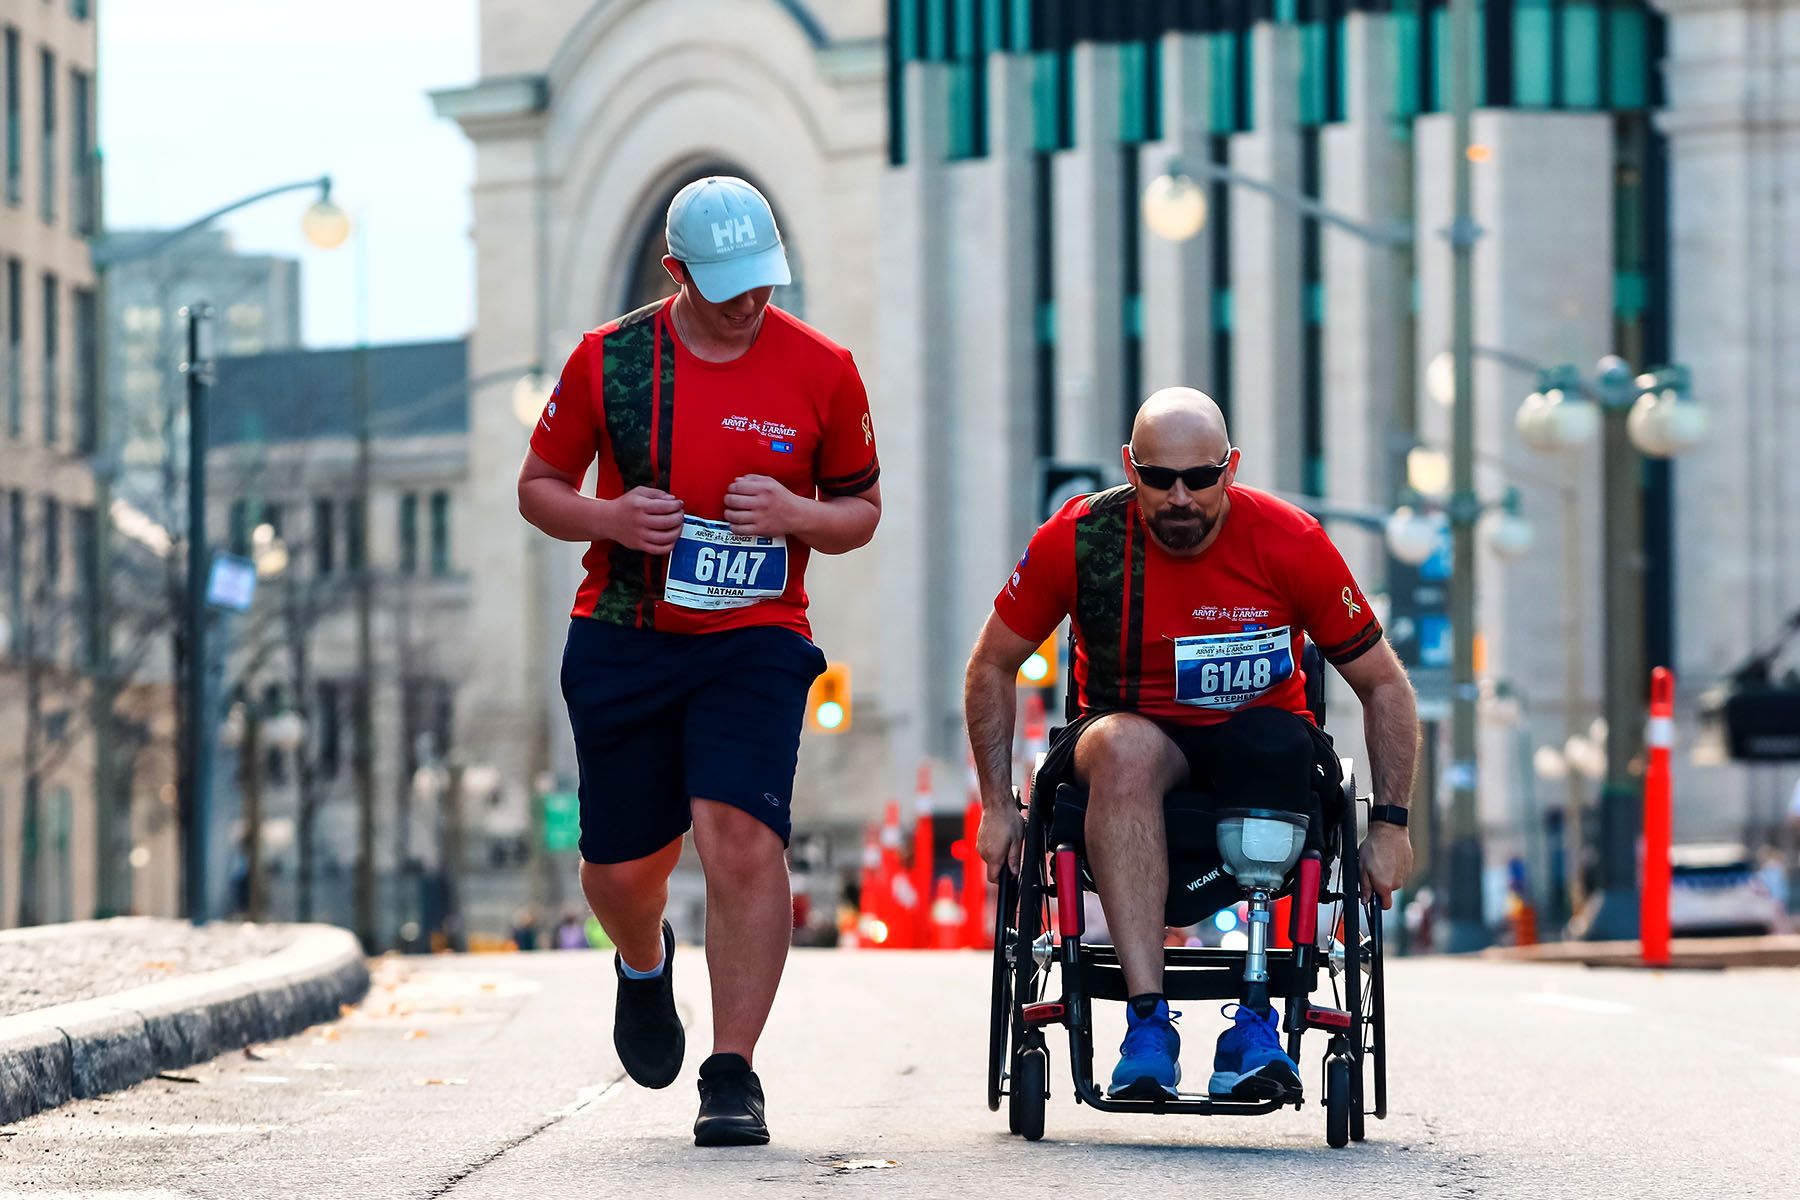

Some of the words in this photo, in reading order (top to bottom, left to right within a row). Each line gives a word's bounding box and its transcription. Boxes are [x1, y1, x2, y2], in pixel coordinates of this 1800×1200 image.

[711, 214, 755, 247] HH
[721, 418, 747, 427] ARMY
[695, 547, 767, 585] 6147
[706, 587, 744, 596] NATHAN
[1192, 609, 1218, 617] ARMY
[1200, 658, 1271, 694] 6148
[1213, 693, 1256, 703] STEPHEN
[1186, 869, 1220, 891] VICAIR
